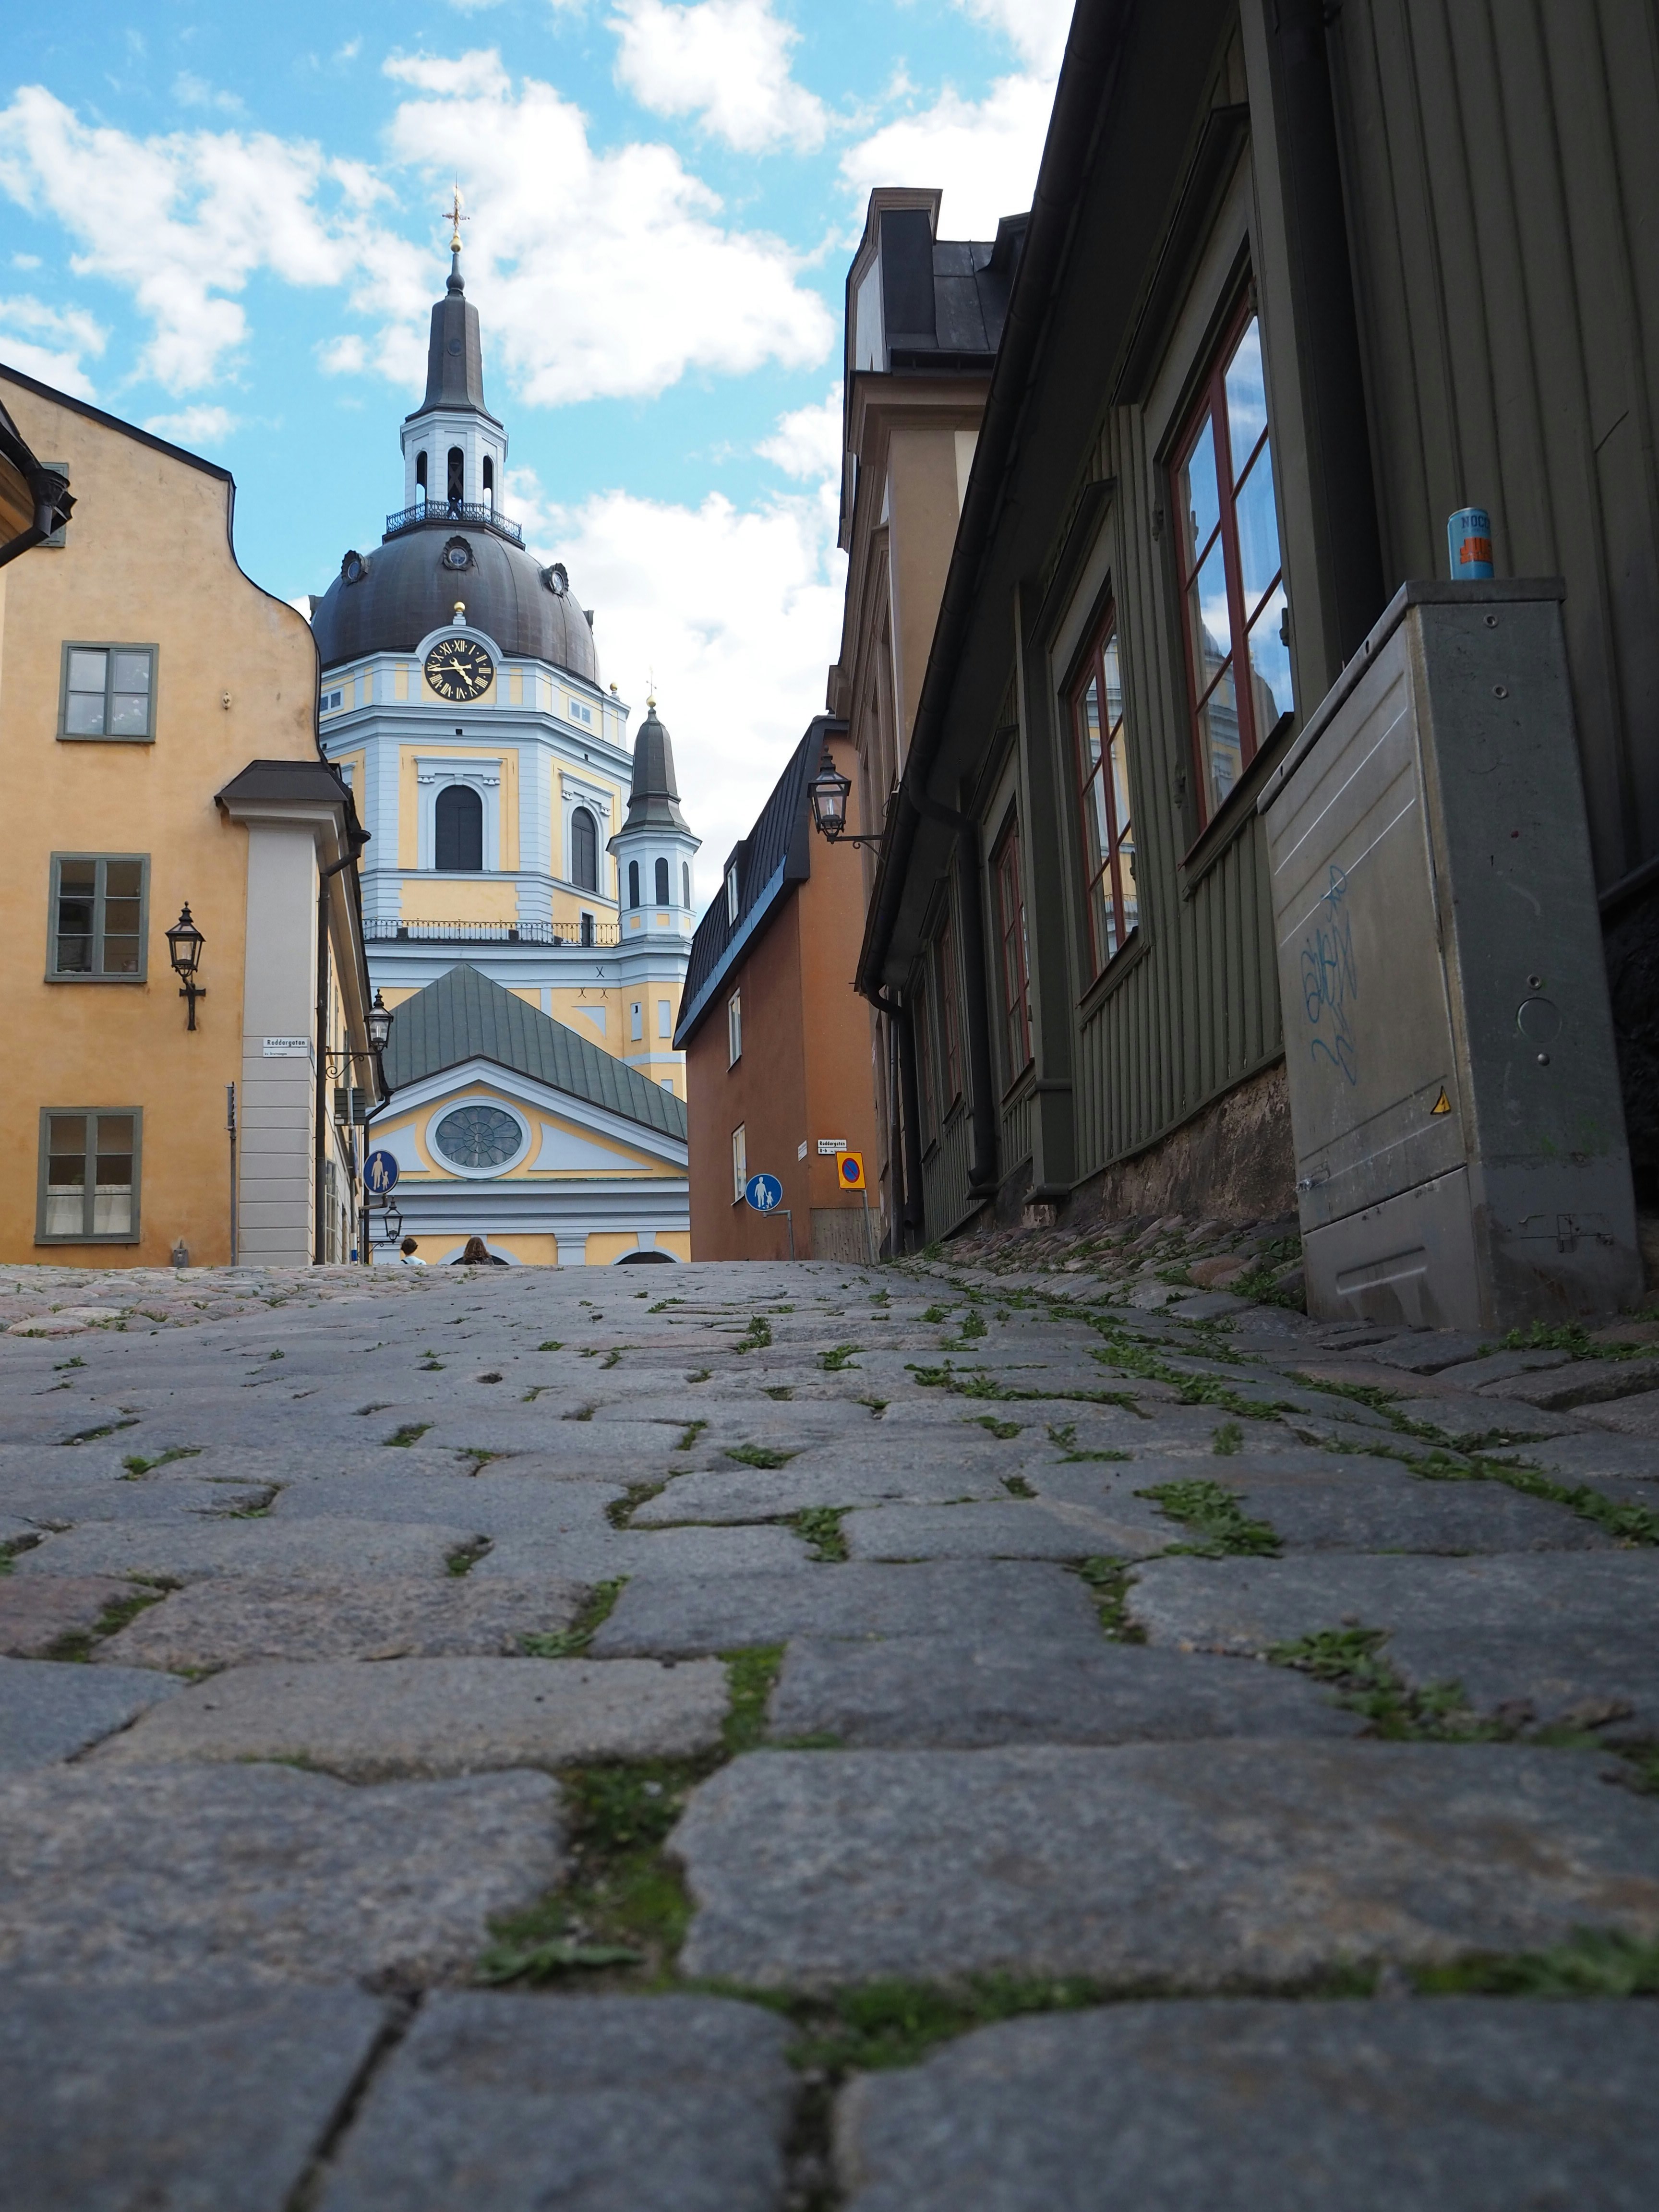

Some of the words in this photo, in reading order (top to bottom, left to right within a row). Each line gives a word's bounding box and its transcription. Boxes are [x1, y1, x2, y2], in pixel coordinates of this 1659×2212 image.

[439, 642, 452, 656] XI
[454, 640, 465, 652] XII
[468, 644, 476, 655] I
[430, 651, 445, 662] X
[475, 654, 488, 663] II
[429, 673, 444, 689] VIII
[474, 676, 489, 688] IIII
[440, 683, 451, 697] VII
[456, 687, 466, 699] VI
[468, 685, 478, 697] V
